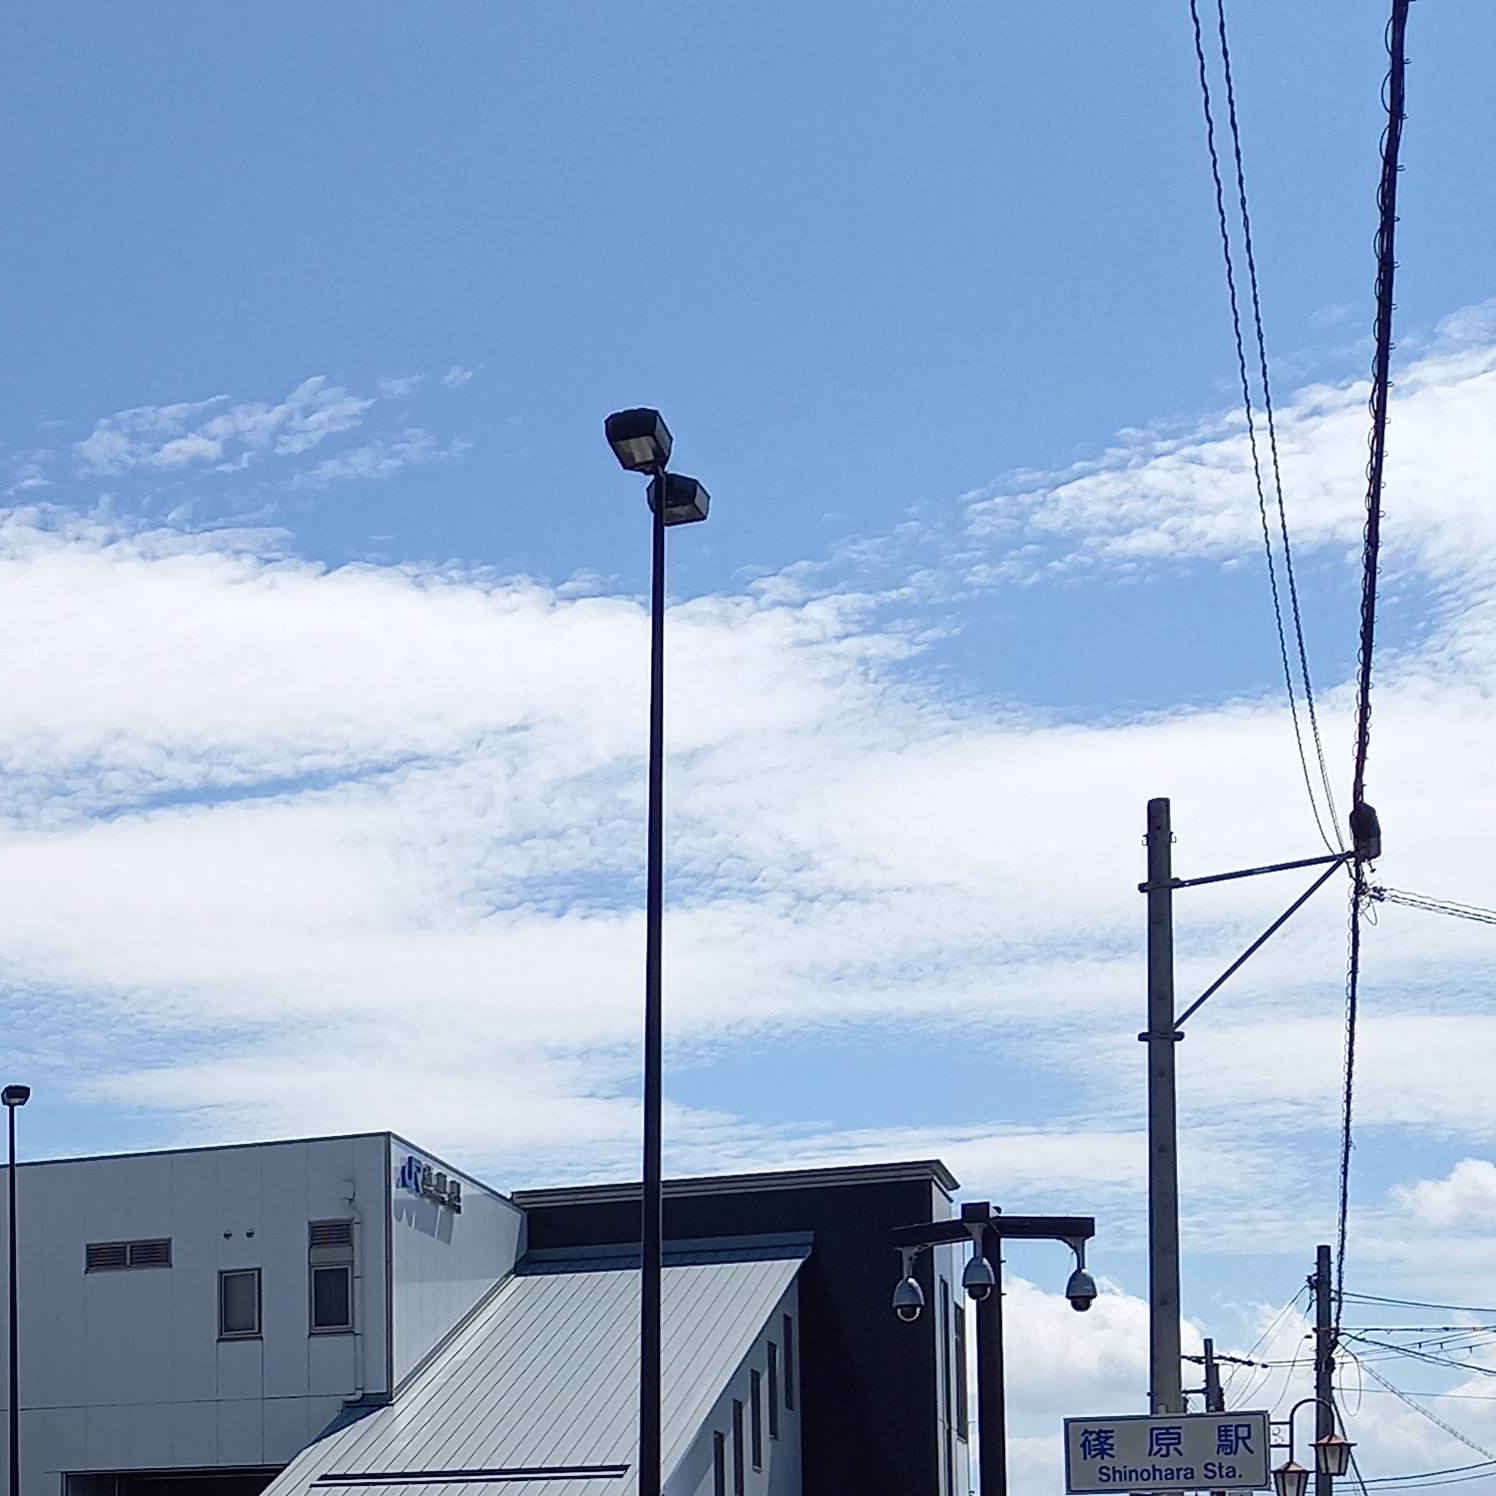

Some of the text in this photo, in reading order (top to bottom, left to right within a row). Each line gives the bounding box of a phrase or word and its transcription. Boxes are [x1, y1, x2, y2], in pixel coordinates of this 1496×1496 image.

[1079, 1423, 1254, 1461] 篠原駅
[1098, 1462, 1243, 1483] Shinohara Sta.
